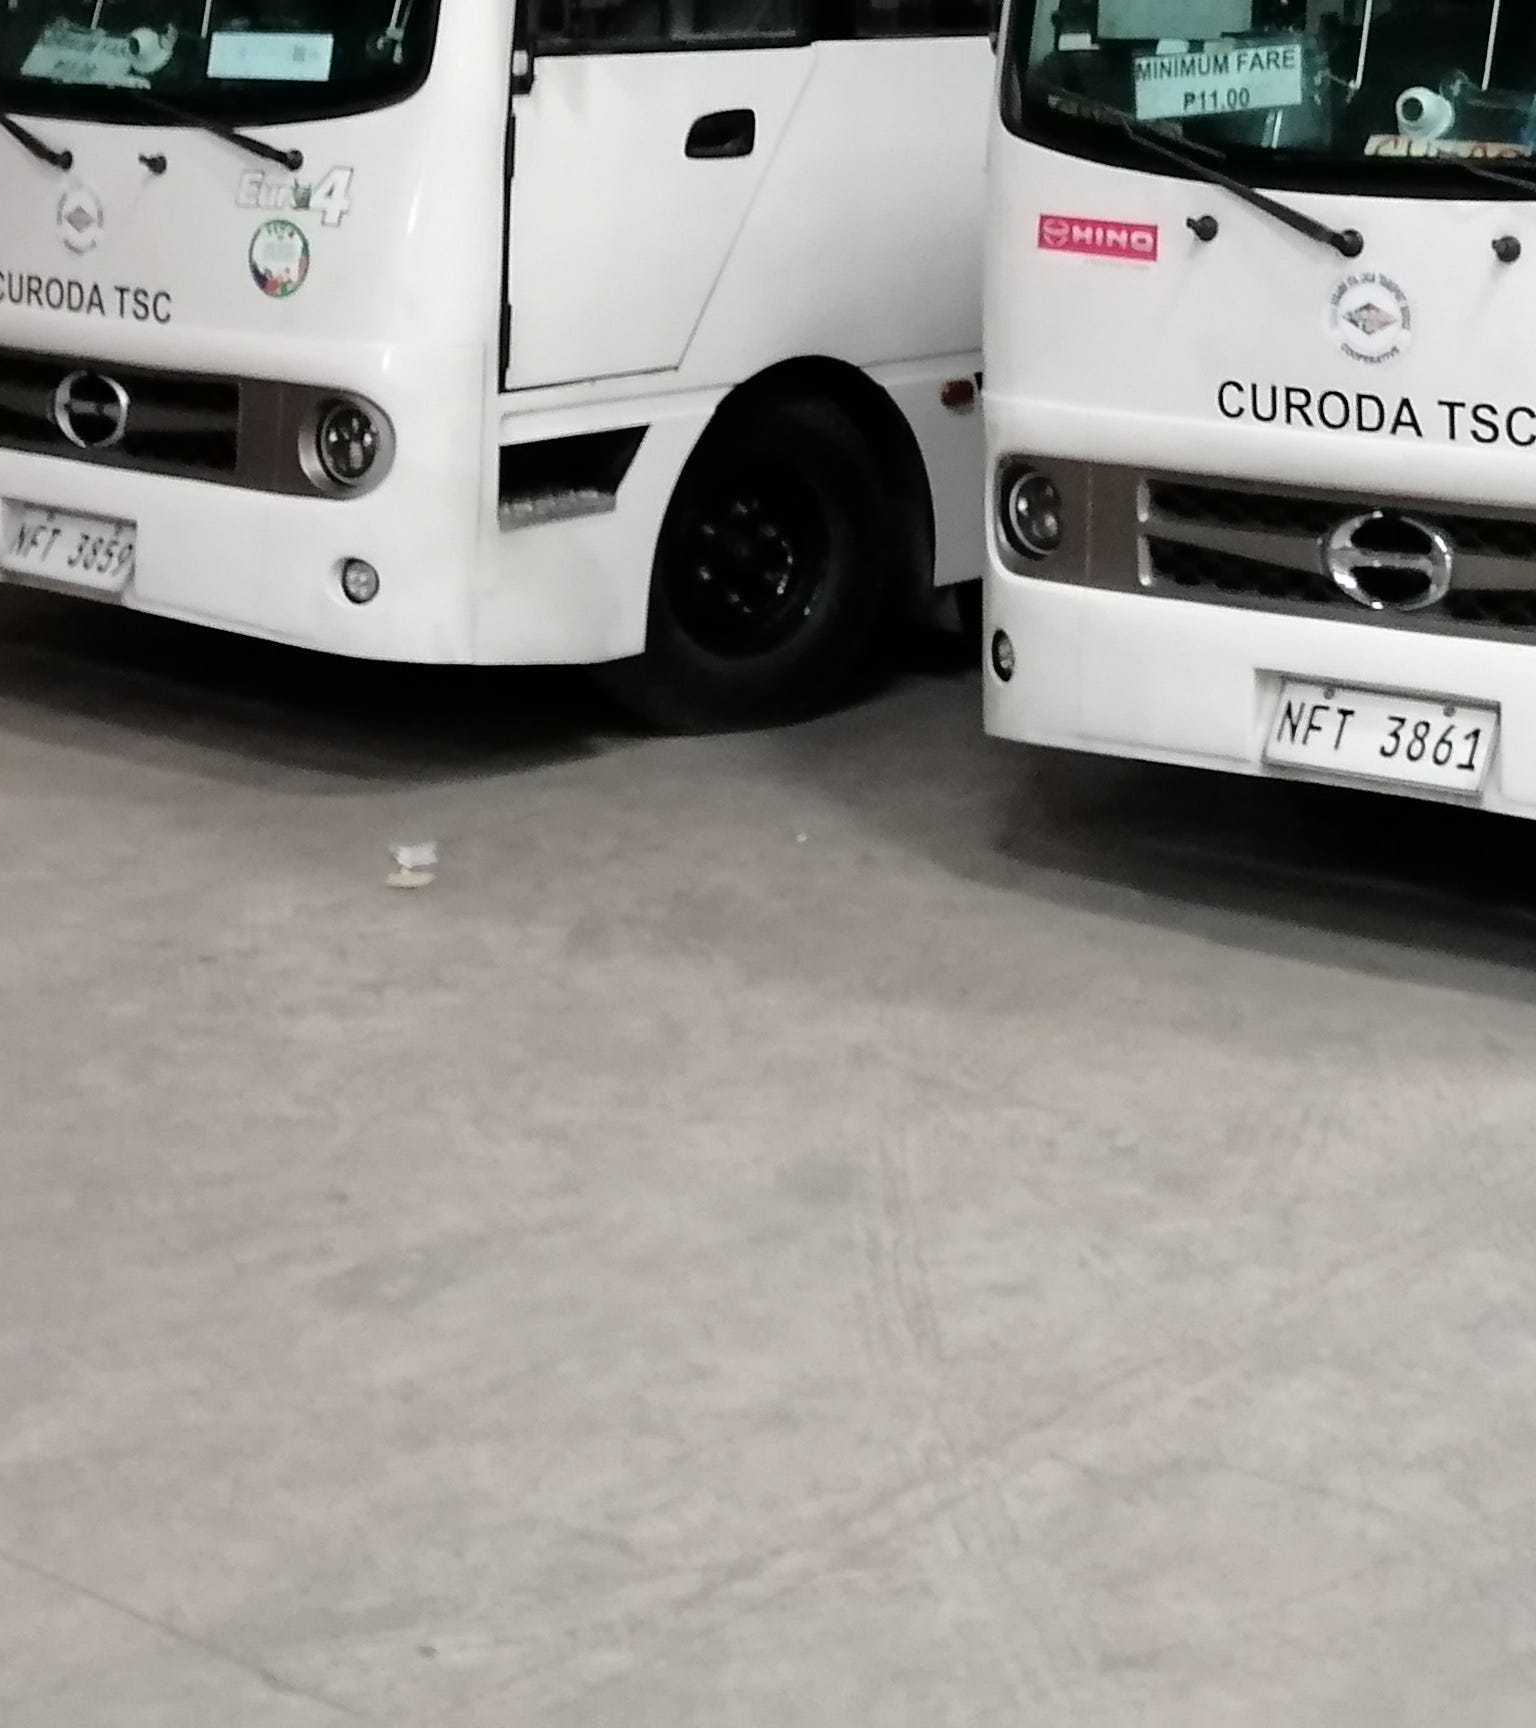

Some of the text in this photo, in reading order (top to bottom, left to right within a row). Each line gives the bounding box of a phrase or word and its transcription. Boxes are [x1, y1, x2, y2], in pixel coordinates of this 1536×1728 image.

[1136, 48, 1296, 81] MINIMUM FARE
[1071, 224, 1154, 252] HINO
[113, 284, 172, 324] TSC
[1217, 380, 1424, 438] CURODA
[1277, 700, 1482, 772] NFT 3861
